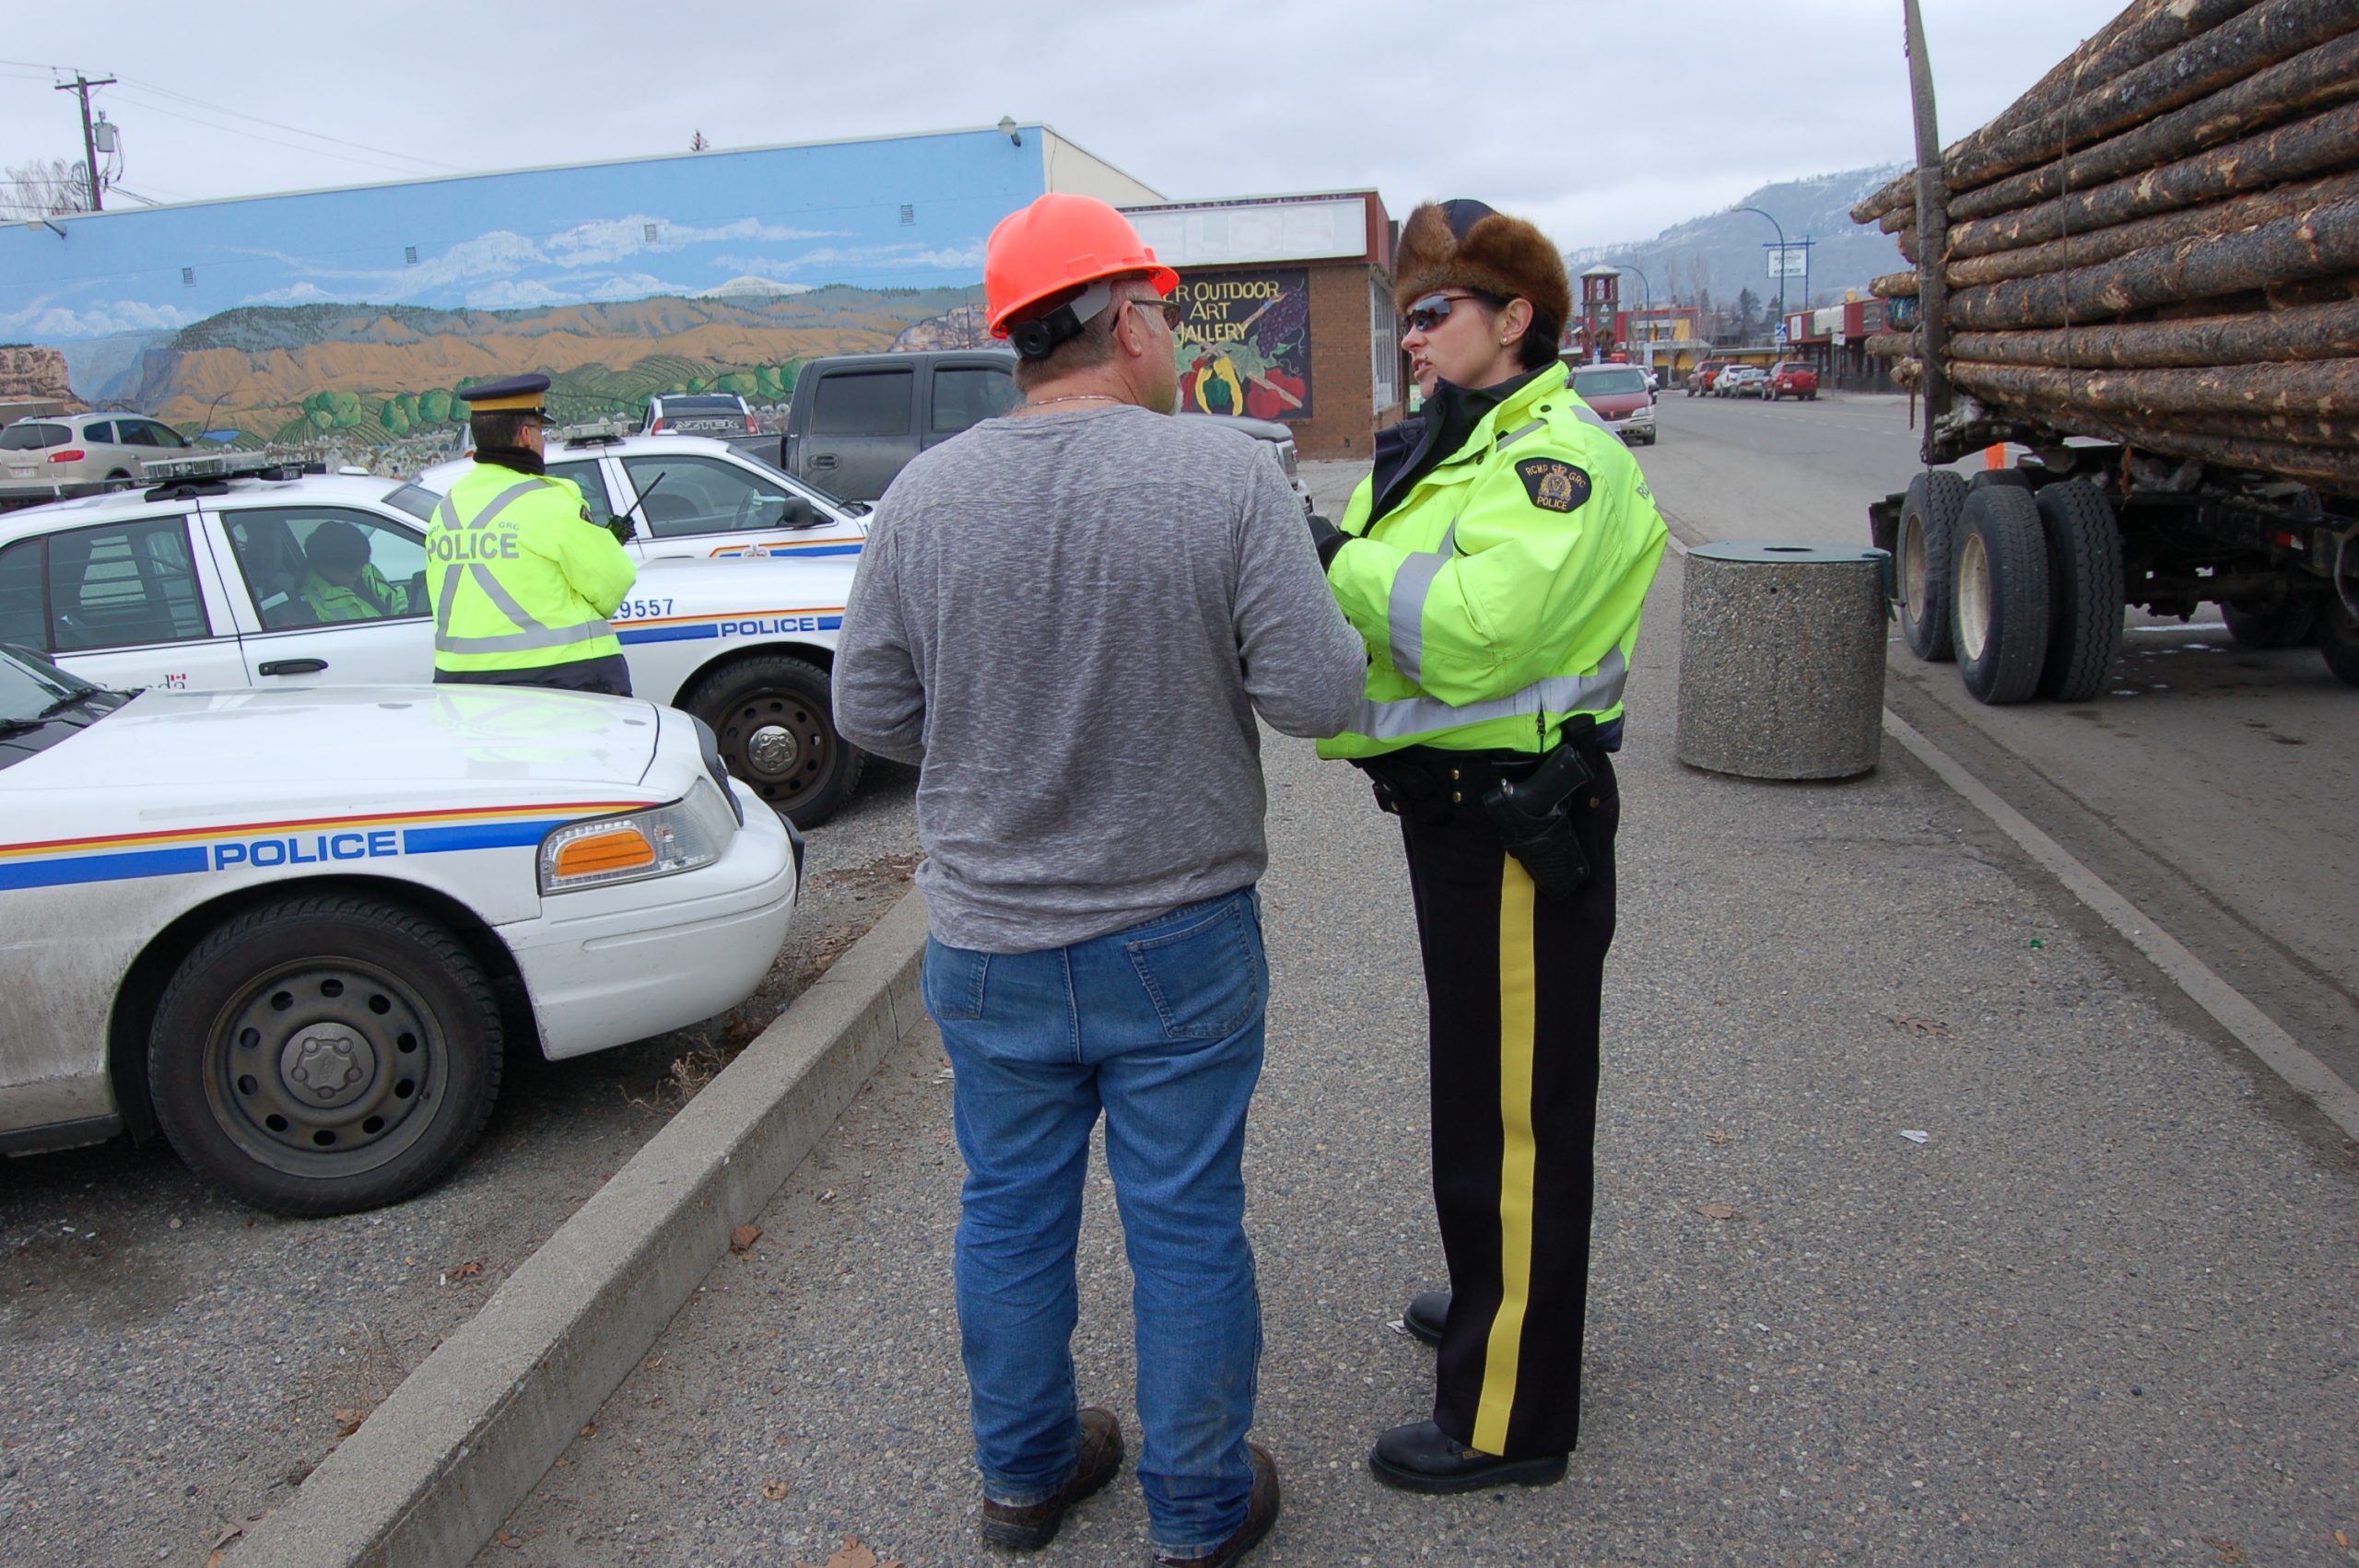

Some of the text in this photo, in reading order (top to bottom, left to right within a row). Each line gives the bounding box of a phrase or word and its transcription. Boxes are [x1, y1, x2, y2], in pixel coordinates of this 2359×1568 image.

[1194, 281, 1280, 301] OUTDOOR
[1190, 301, 1231, 320] ART
[670, 419, 739, 431] AZTEK
[1525, 465, 1587, 488] RCMP GRC
[1536, 496, 1568, 510] POLICE
[499, 521, 520, 531] GRC
[428, 532, 520, 562] POLICE
[613, 599, 674, 620] 9557
[721, 617, 816, 638] POLICE
[215, 831, 398, 871] POLICE
